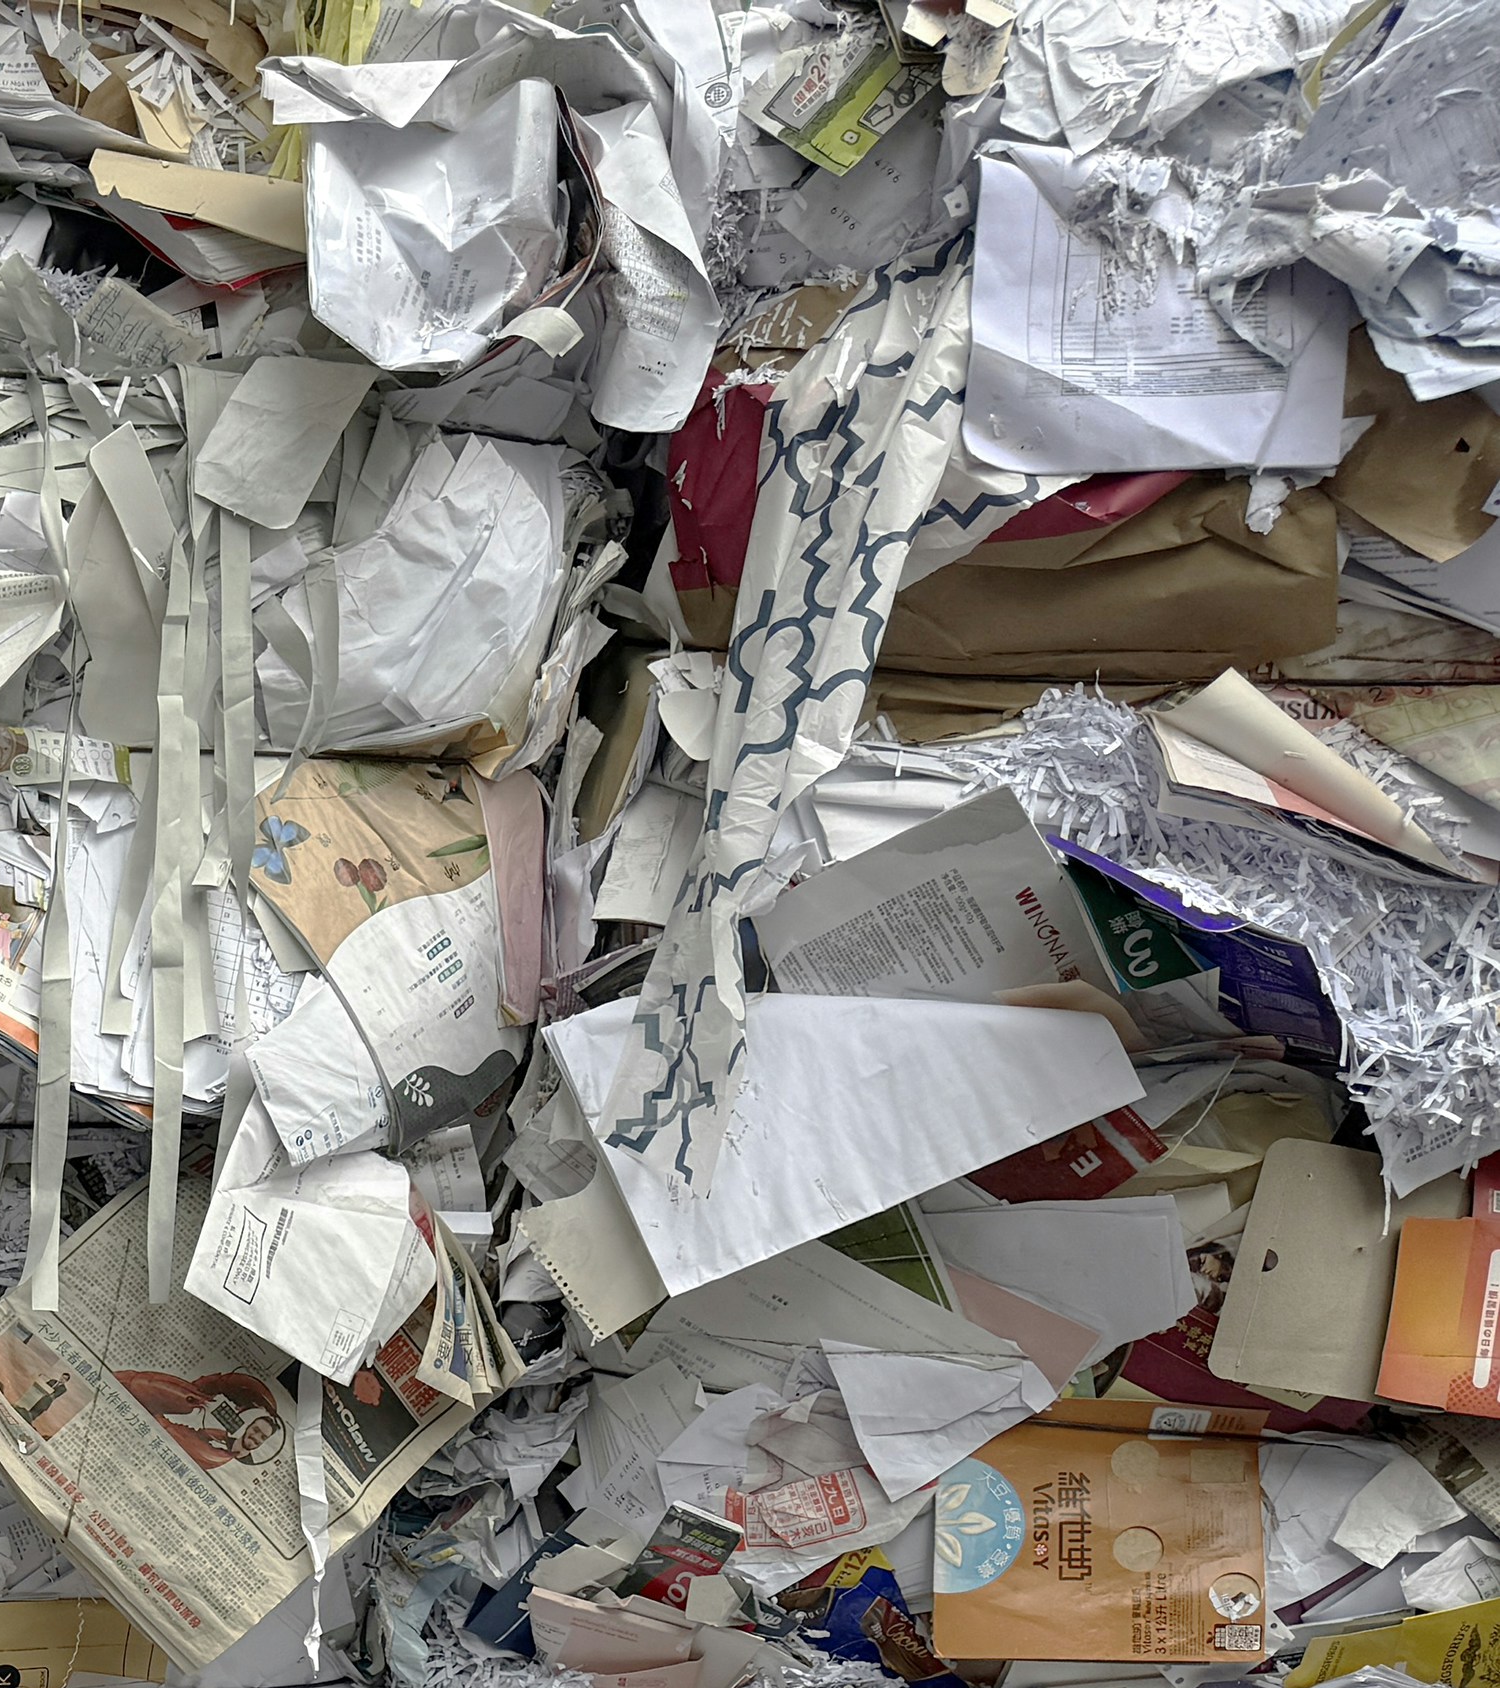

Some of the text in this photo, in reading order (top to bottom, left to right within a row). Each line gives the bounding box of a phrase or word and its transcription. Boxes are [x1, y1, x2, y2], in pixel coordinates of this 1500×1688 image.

[1017, 886, 1069, 965] WINONA
[1056, 1471, 1093, 1582] 維他奶
